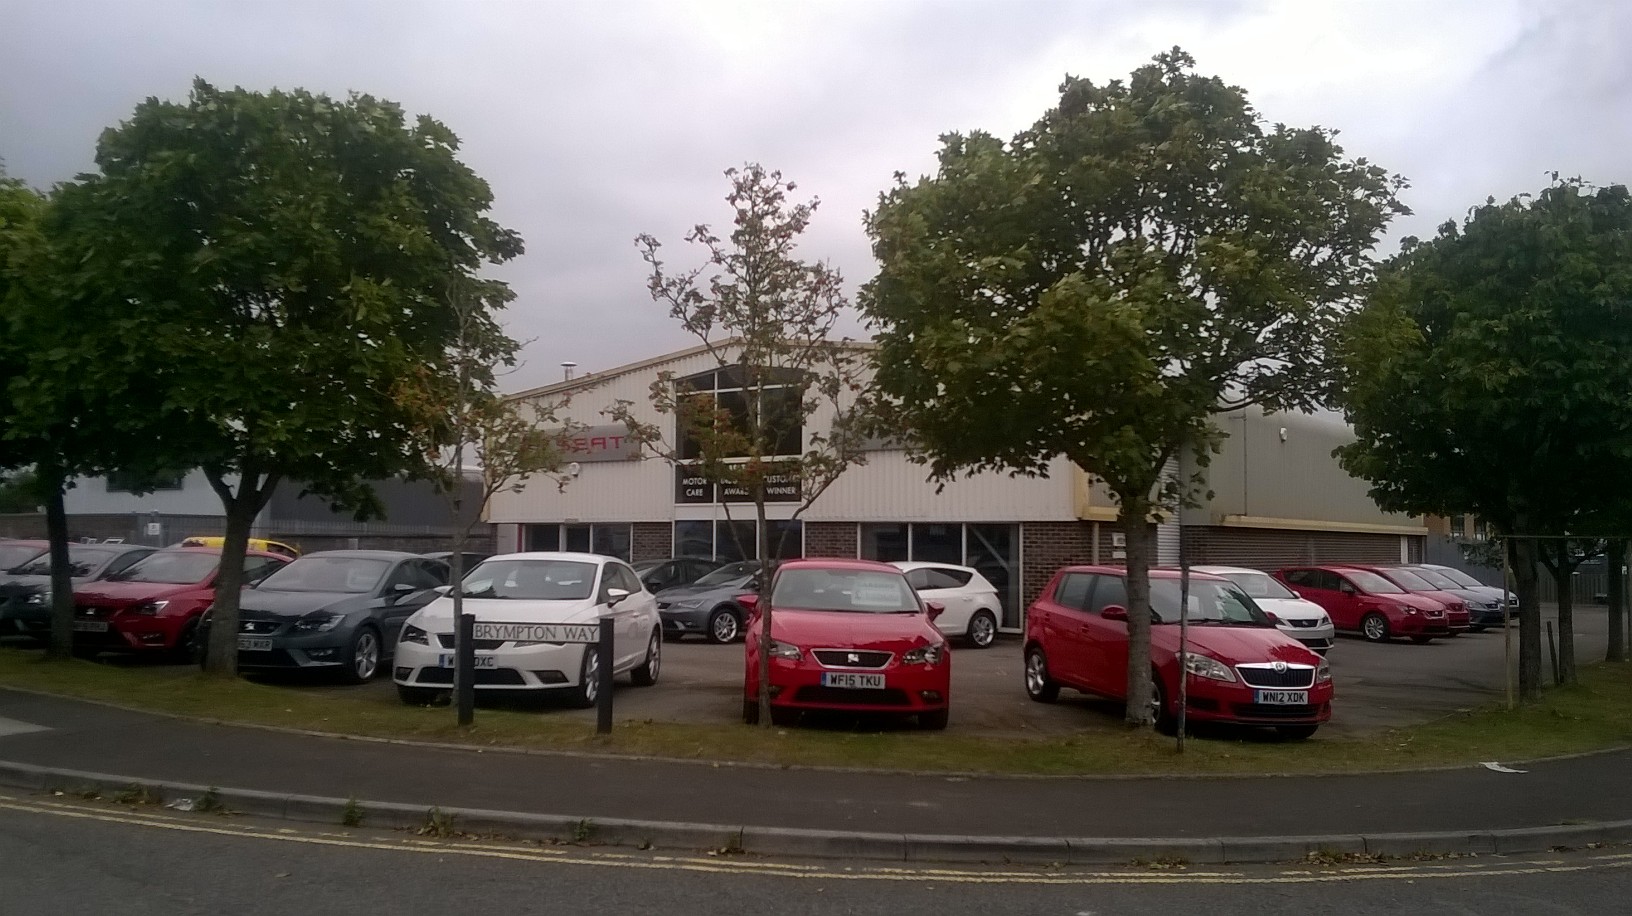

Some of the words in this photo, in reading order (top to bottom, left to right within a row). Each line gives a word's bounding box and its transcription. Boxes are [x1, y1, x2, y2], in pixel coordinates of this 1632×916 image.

[557, 436, 624, 451] SEAT
[683, 477, 707, 485] MOTOR
[686, 488, 703, 497] CARE
[766, 486, 796, 495] WINNER
[475, 625, 557, 640] BRYMPTON
[564, 626, 599, 641] WAY
[830, 674, 855, 685] WF15
[860, 675, 881, 687] TKU
[1263, 691, 1284, 702] WN12
